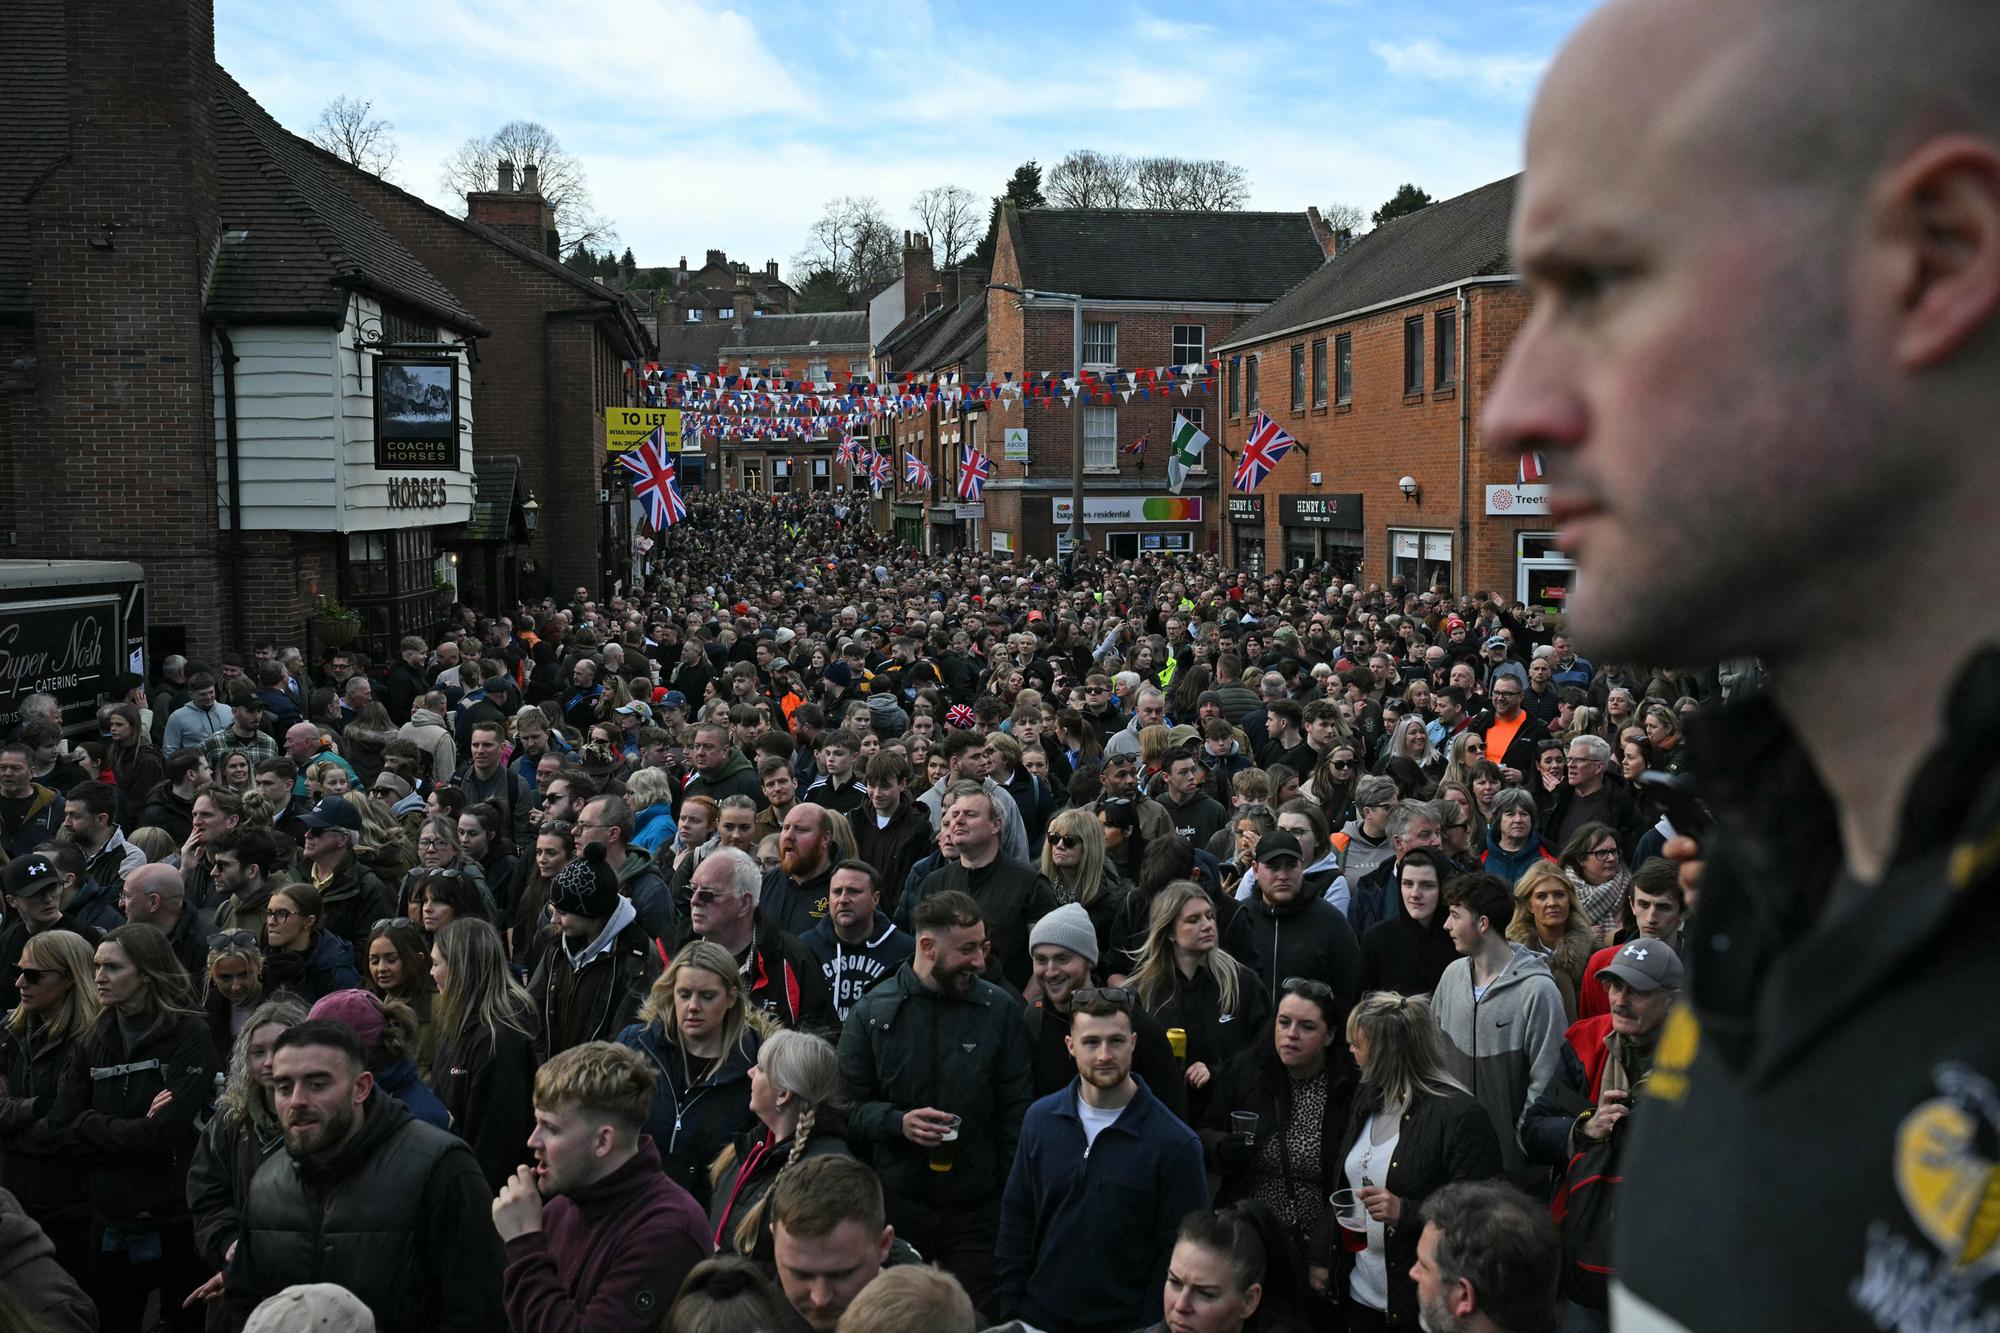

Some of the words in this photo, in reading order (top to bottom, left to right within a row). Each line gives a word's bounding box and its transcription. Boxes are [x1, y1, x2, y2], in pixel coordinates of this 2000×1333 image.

[622, 412, 641, 426] TO
[646, 413, 667, 426] LET
[387, 442, 433, 450] COACH
[437, 442, 446, 451] &
[387, 452, 446, 461] HORSES
[388, 476, 447, 508] HORSES
[1229, 500, 1247, 511] HENRY
[1247, 500, 1252, 511] &
[1515, 495, 1550, 504] Treeto
[1297, 500, 1319, 513] HENRY
[1321, 501, 1326, 513] &
[1056, 510, 1092, 520] bagsws
[1093, 510, 1131, 518] residential
[0, 623, 48, 698] Super
[51, 616, 102, 672] Nosh
[35, 674, 78, 693] CATERING
[11, 711, 20, 723] 15
[1175, 825, 1196, 837] Angeles
